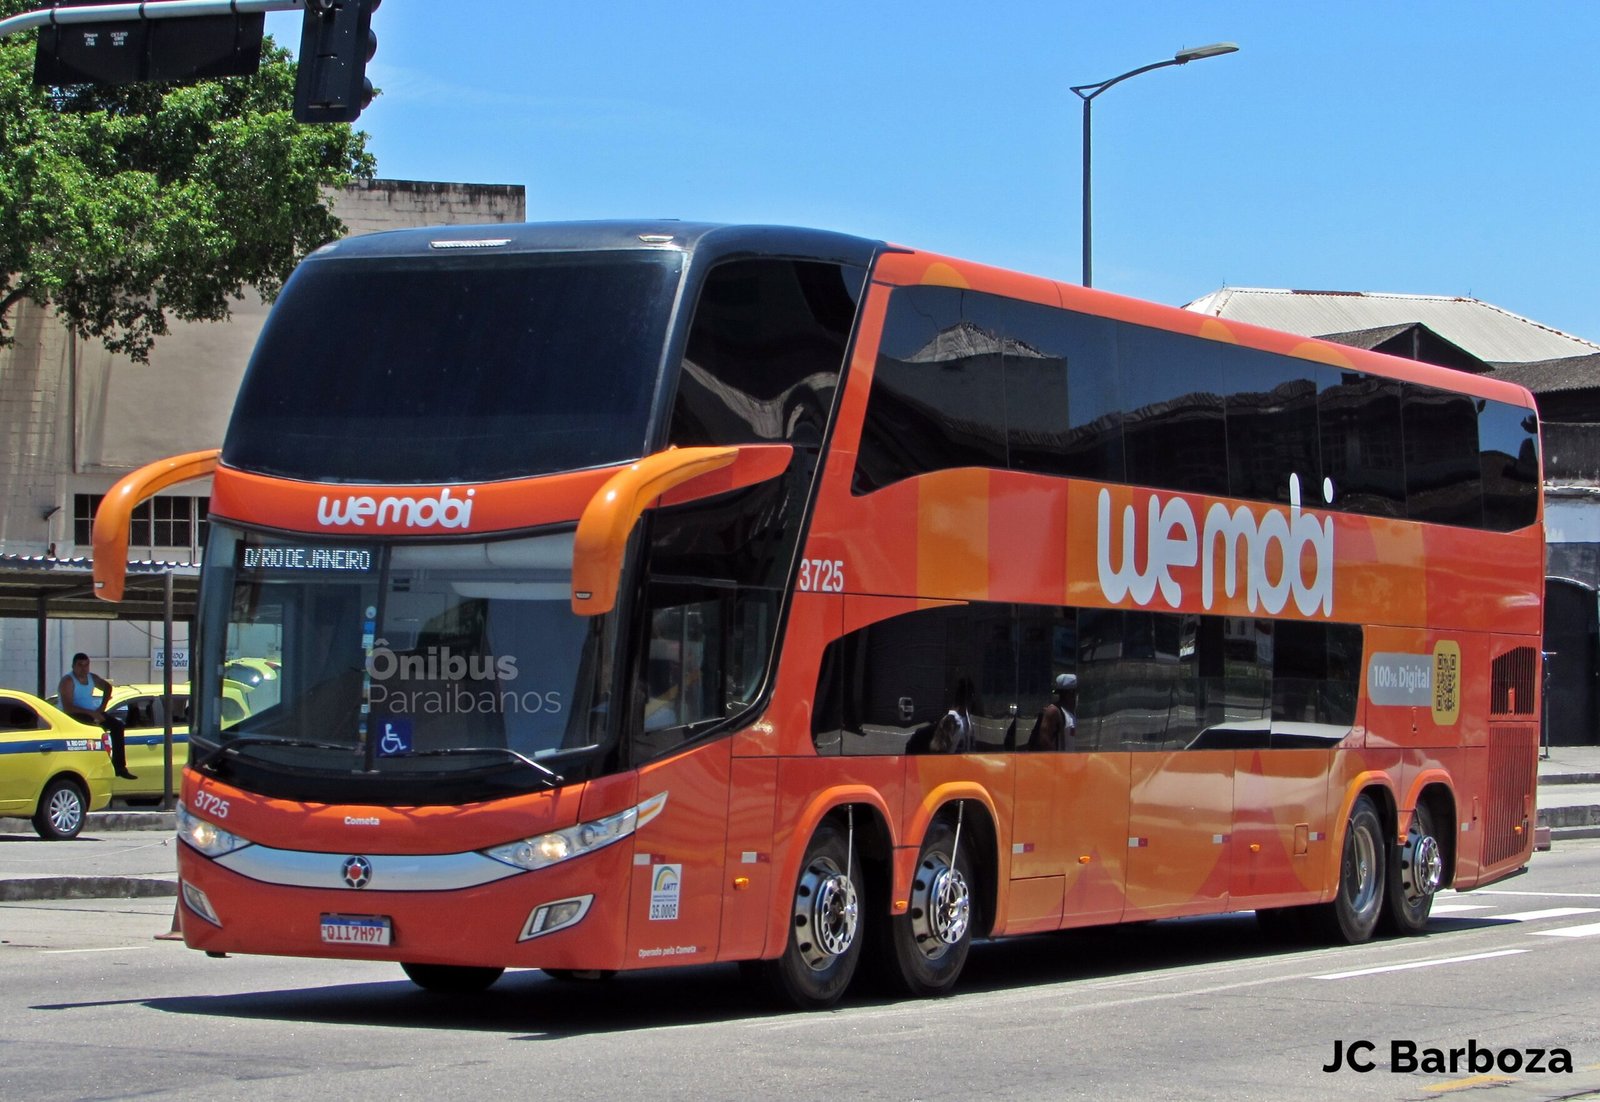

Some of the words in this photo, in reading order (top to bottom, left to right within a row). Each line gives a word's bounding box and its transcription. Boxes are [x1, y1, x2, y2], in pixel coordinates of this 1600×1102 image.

[284, 549, 305, 568] DE
[305, 549, 371, 570] JANEIRO
[799, 558, 844, 592] 3725
[1373, 665, 1397, 688] 100%
[1398, 665, 1430, 694] Digital
[193, 790, 231, 818] 3725
[343, 816, 380, 826] Cometa
[662, 883, 678, 891] ANTT
[638, 947, 662, 959] Operado
[675, 945, 697, 955] Cometa
